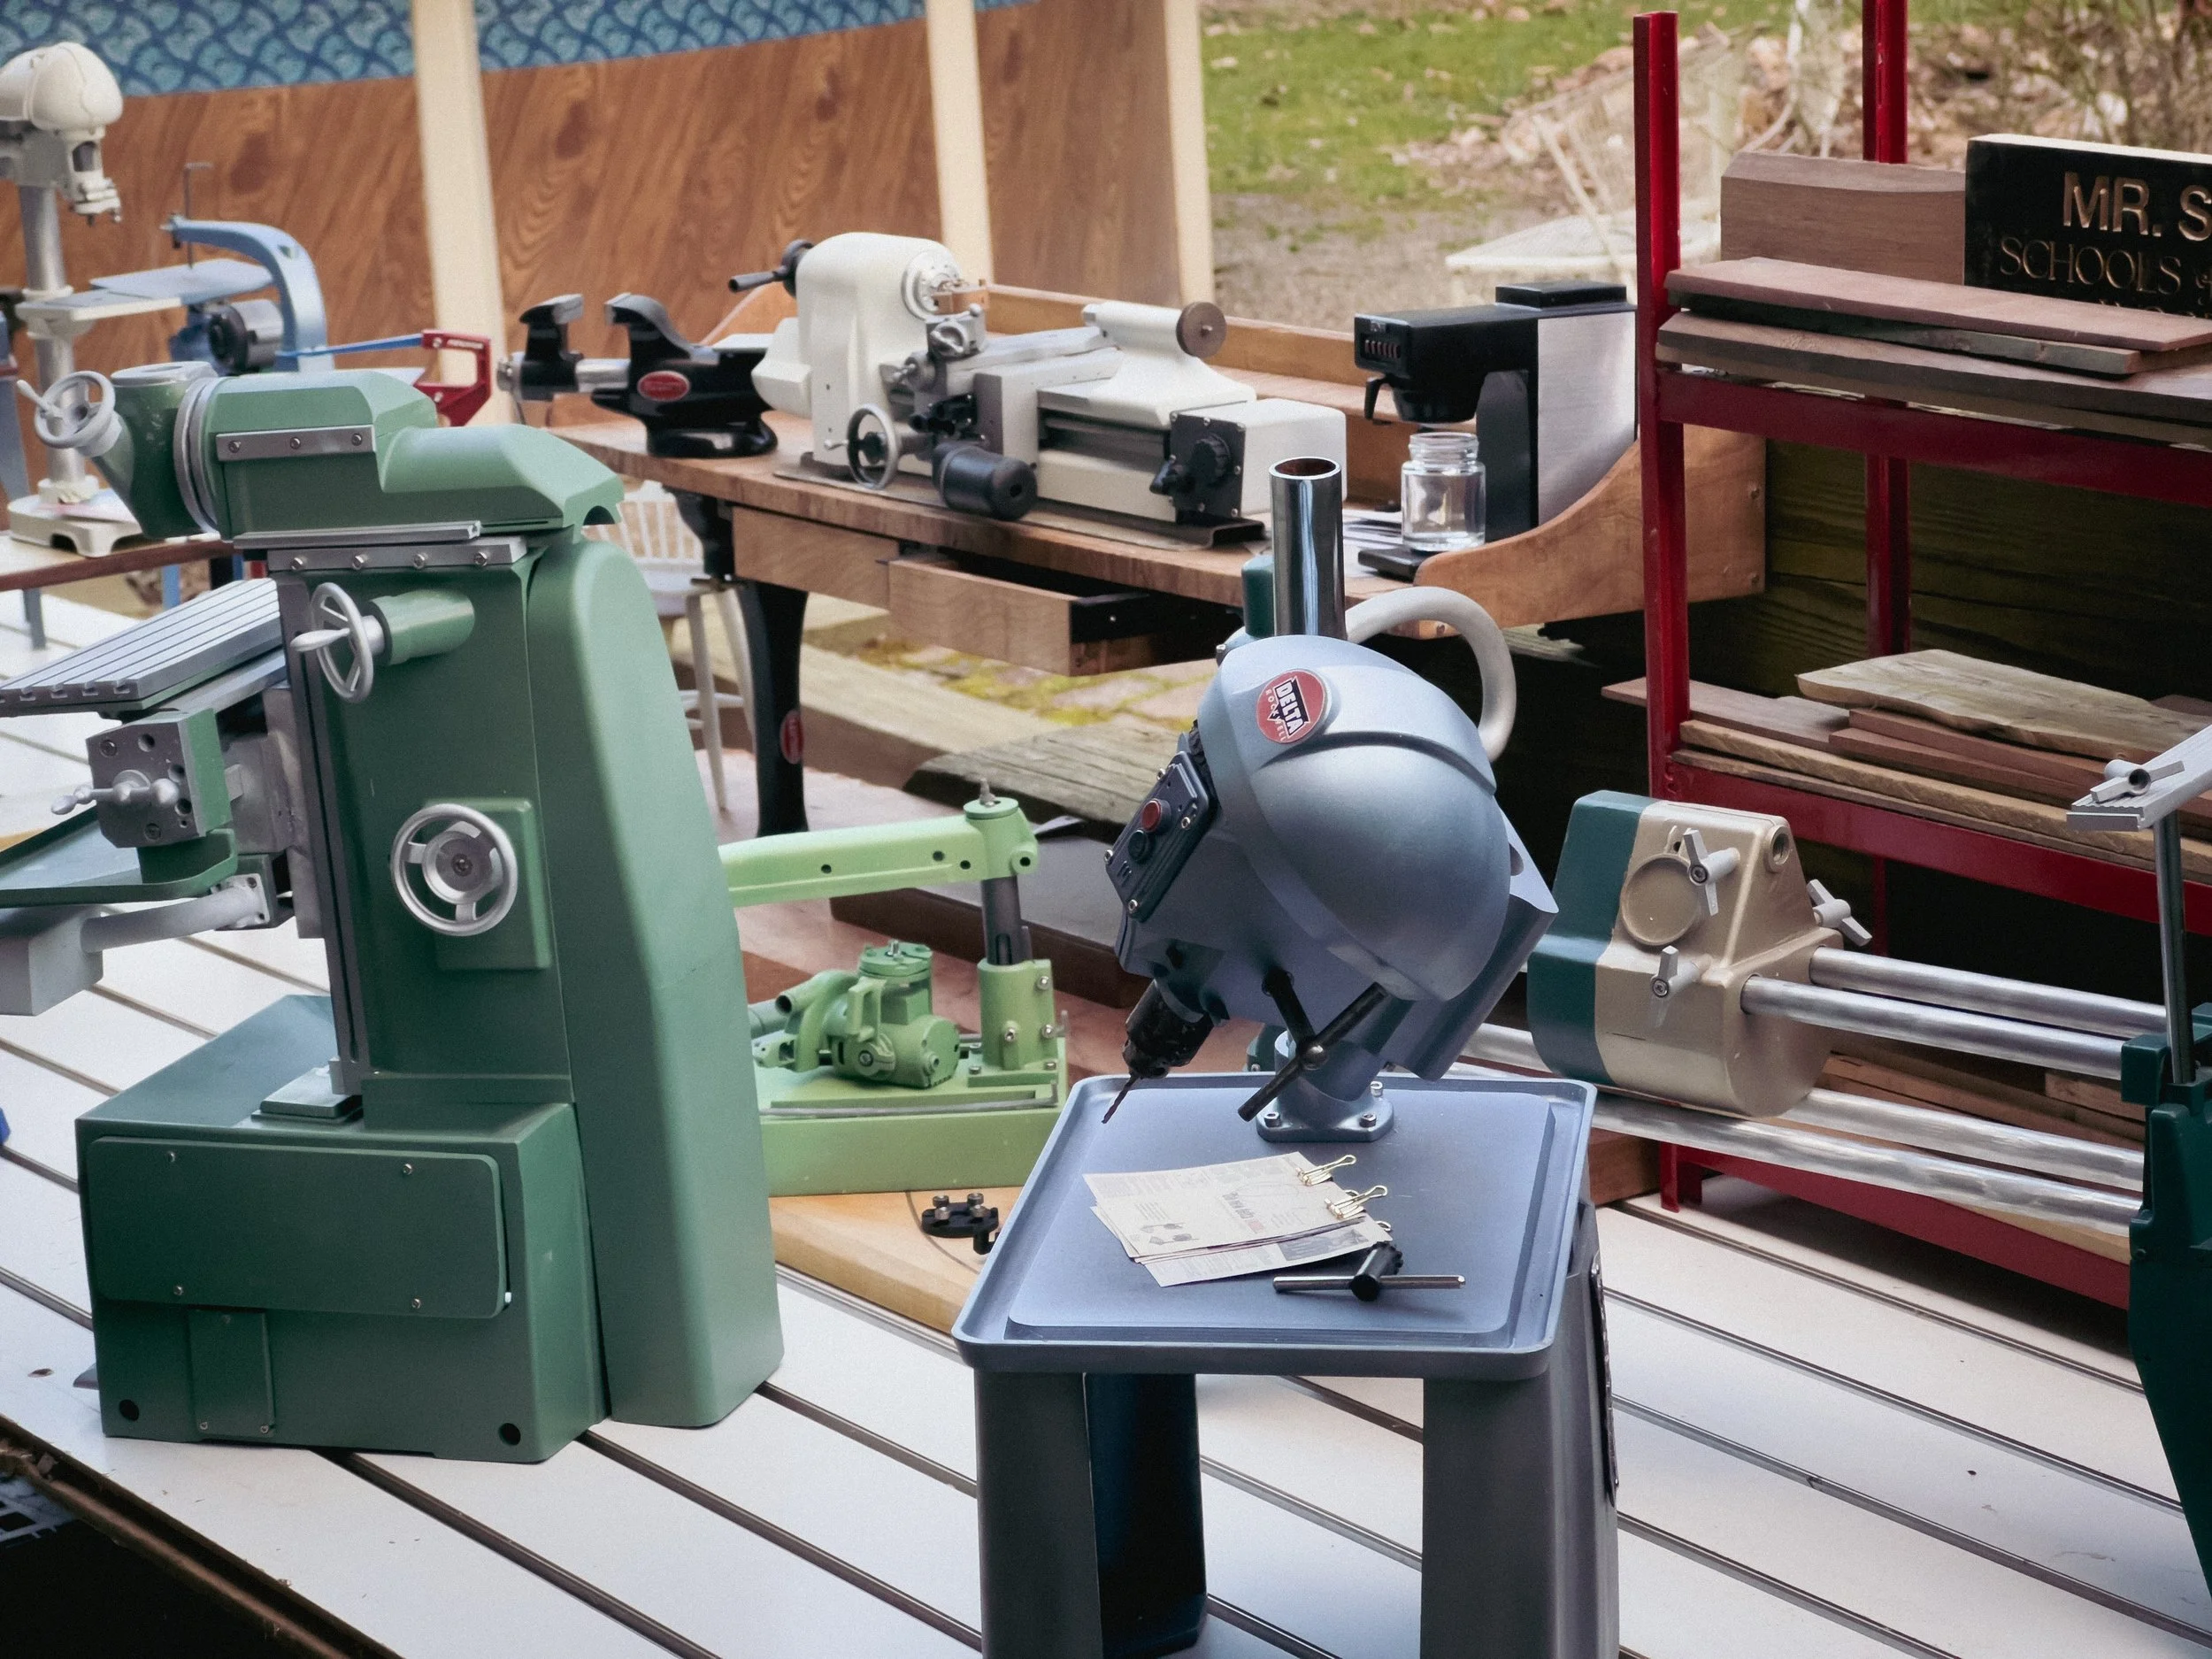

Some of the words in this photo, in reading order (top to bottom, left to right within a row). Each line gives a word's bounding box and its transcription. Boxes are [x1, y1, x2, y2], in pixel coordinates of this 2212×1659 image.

[2063, 171, 2162, 237] MR.
[2000, 235, 2182, 296] SCHOOLS
[1265, 688, 1286, 741] ROCKWELL
[1275, 680, 1304, 735] DELTA
